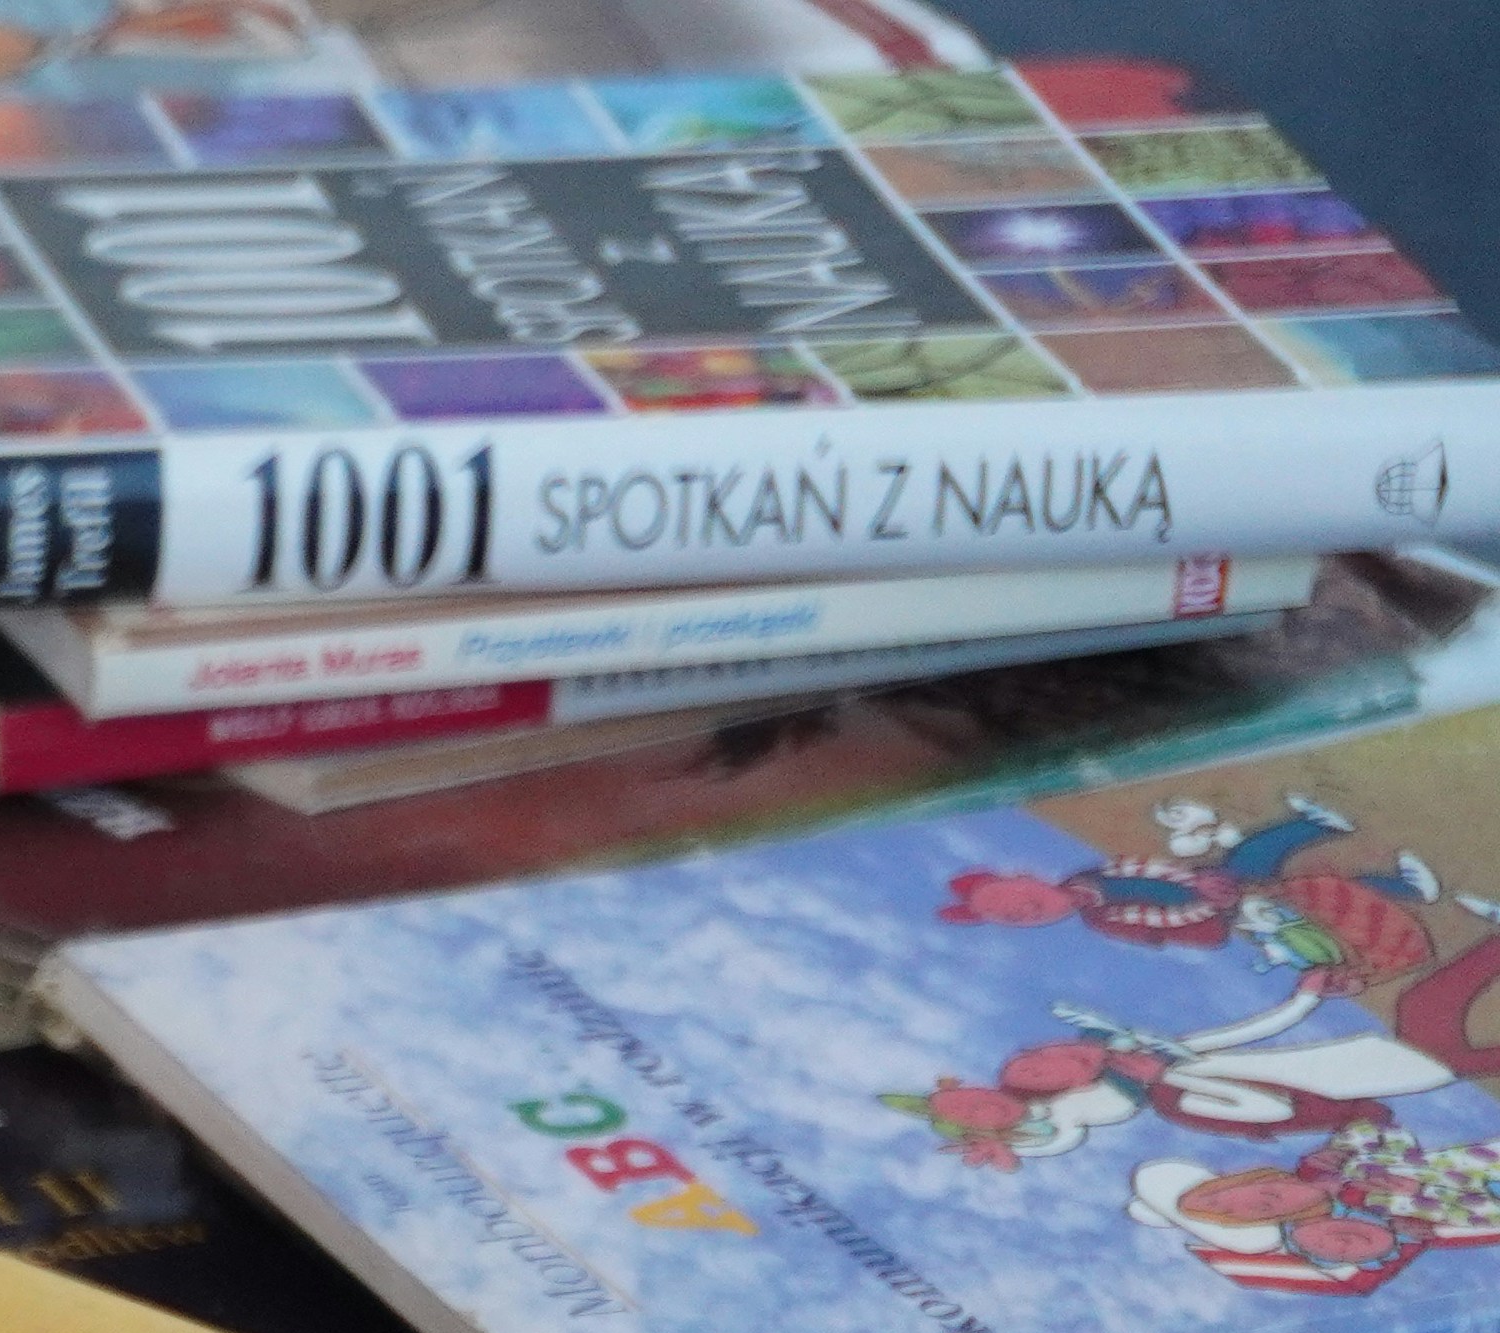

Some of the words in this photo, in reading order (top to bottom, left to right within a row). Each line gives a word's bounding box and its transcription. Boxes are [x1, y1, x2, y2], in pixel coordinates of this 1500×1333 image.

[60, 178, 438, 346] 1001
[240, 440, 497, 594] 1001
[534, 436, 846, 556] SPOTKAŃ
[874, 462, 910, 541] Z
[933, 448, 1174, 545] NAUKĄ
